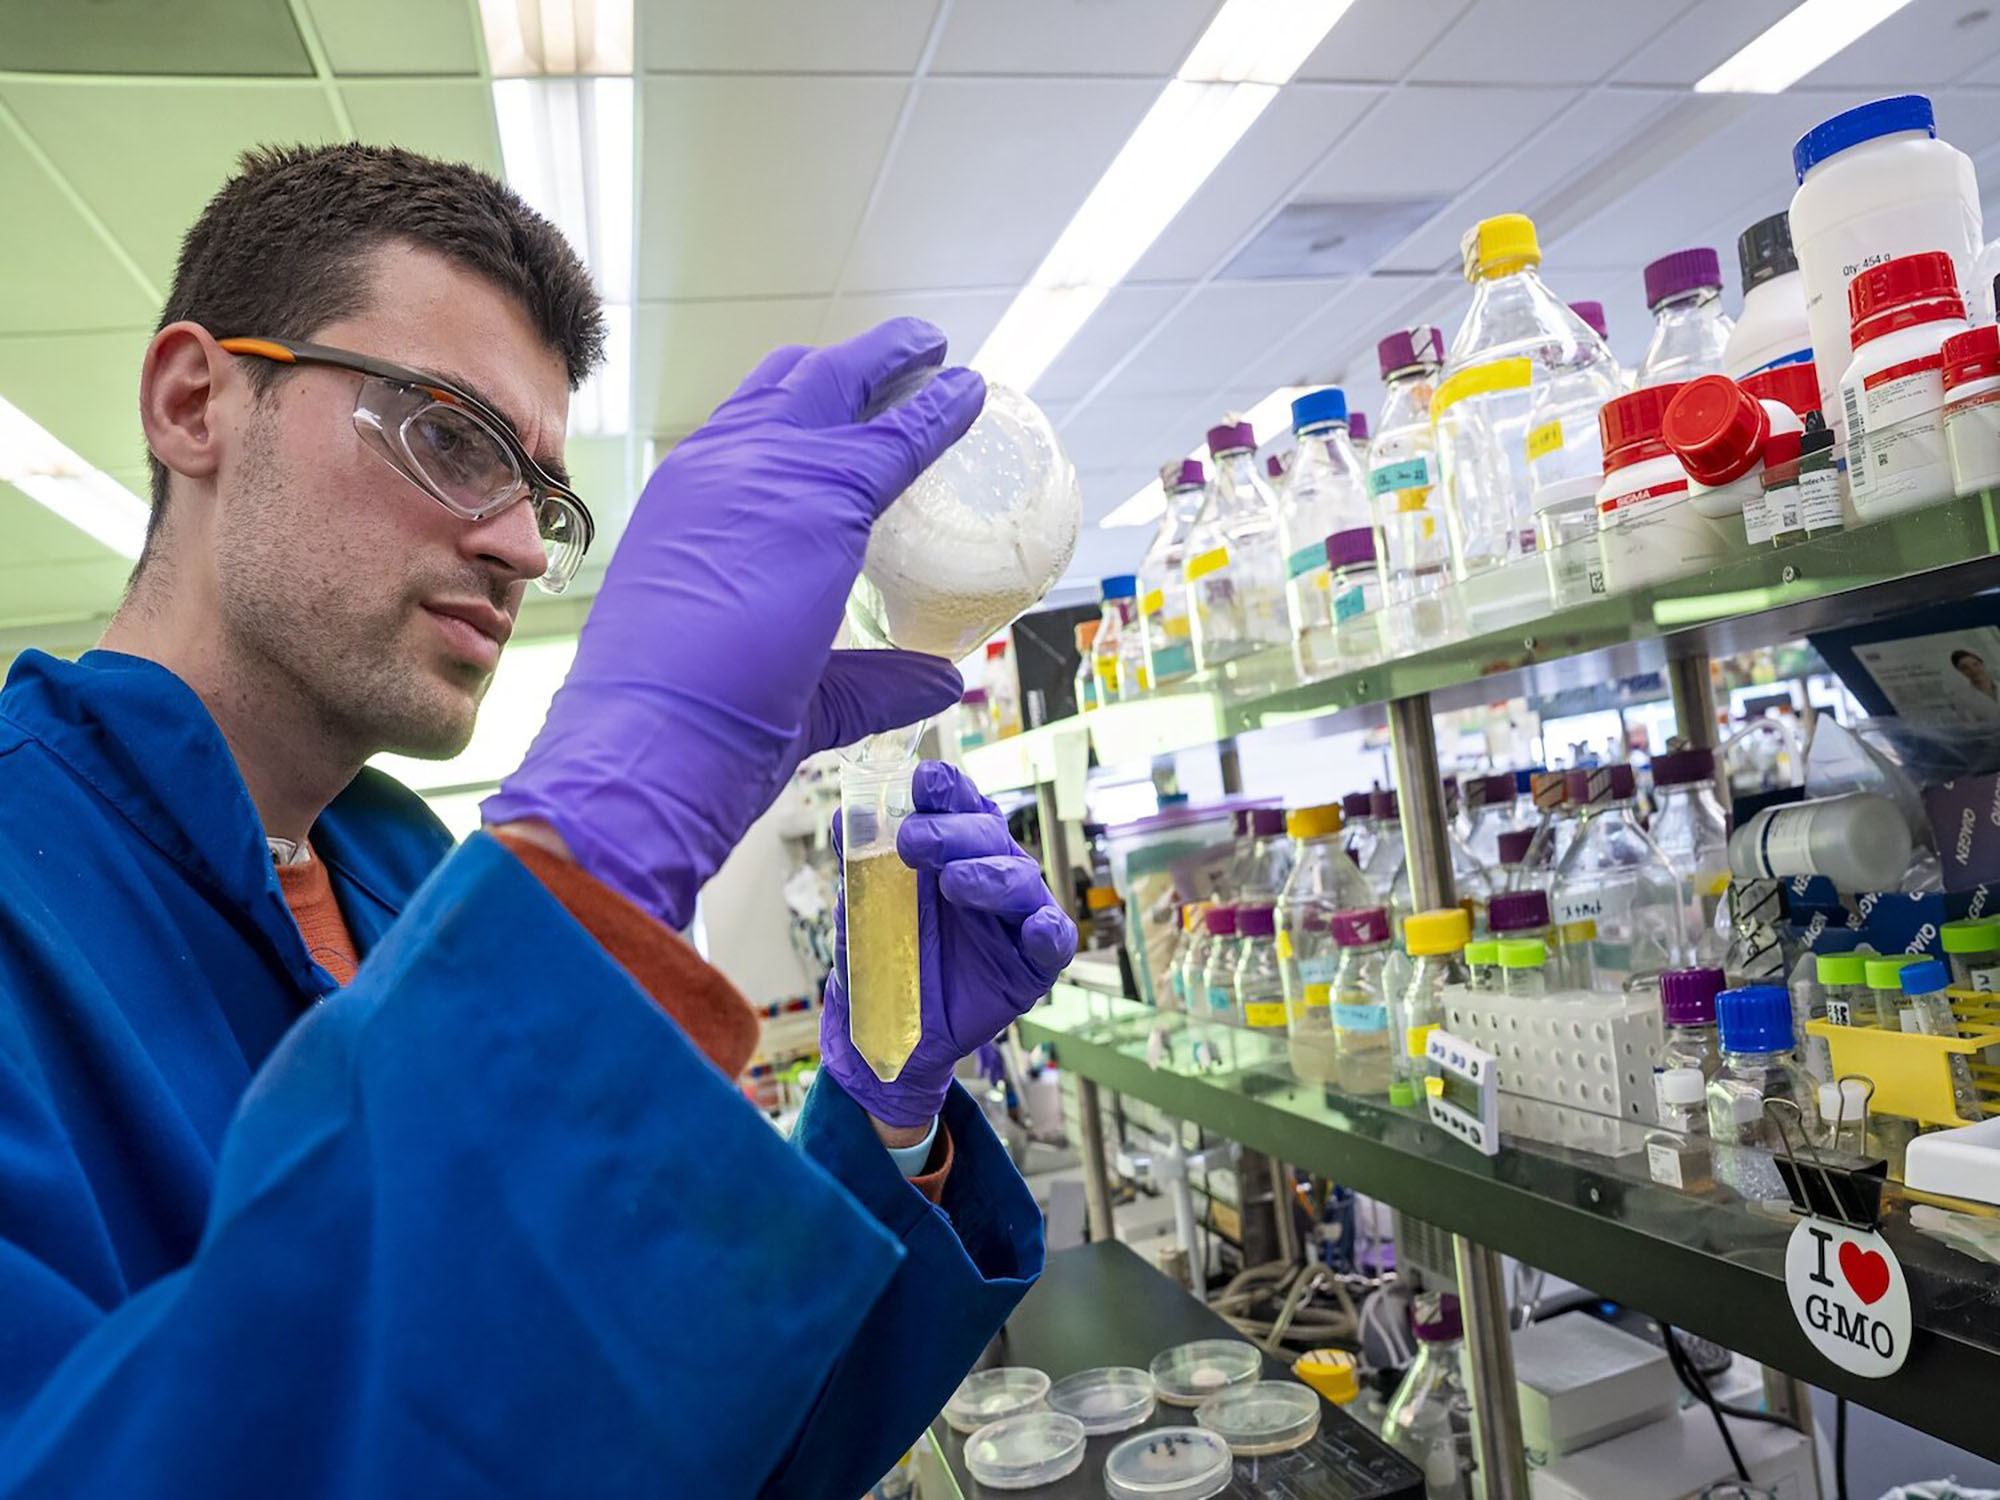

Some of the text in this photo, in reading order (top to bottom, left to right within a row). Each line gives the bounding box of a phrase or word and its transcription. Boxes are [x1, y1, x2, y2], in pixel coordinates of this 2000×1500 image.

[1863, 254, 1881, 267] 454
[1616, 489, 1651, 507] SIGMA
[1956, 808, 1976, 866] QIAGEN
[1809, 1227, 1834, 1288] I
[1805, 1294, 1894, 1358] GMO
